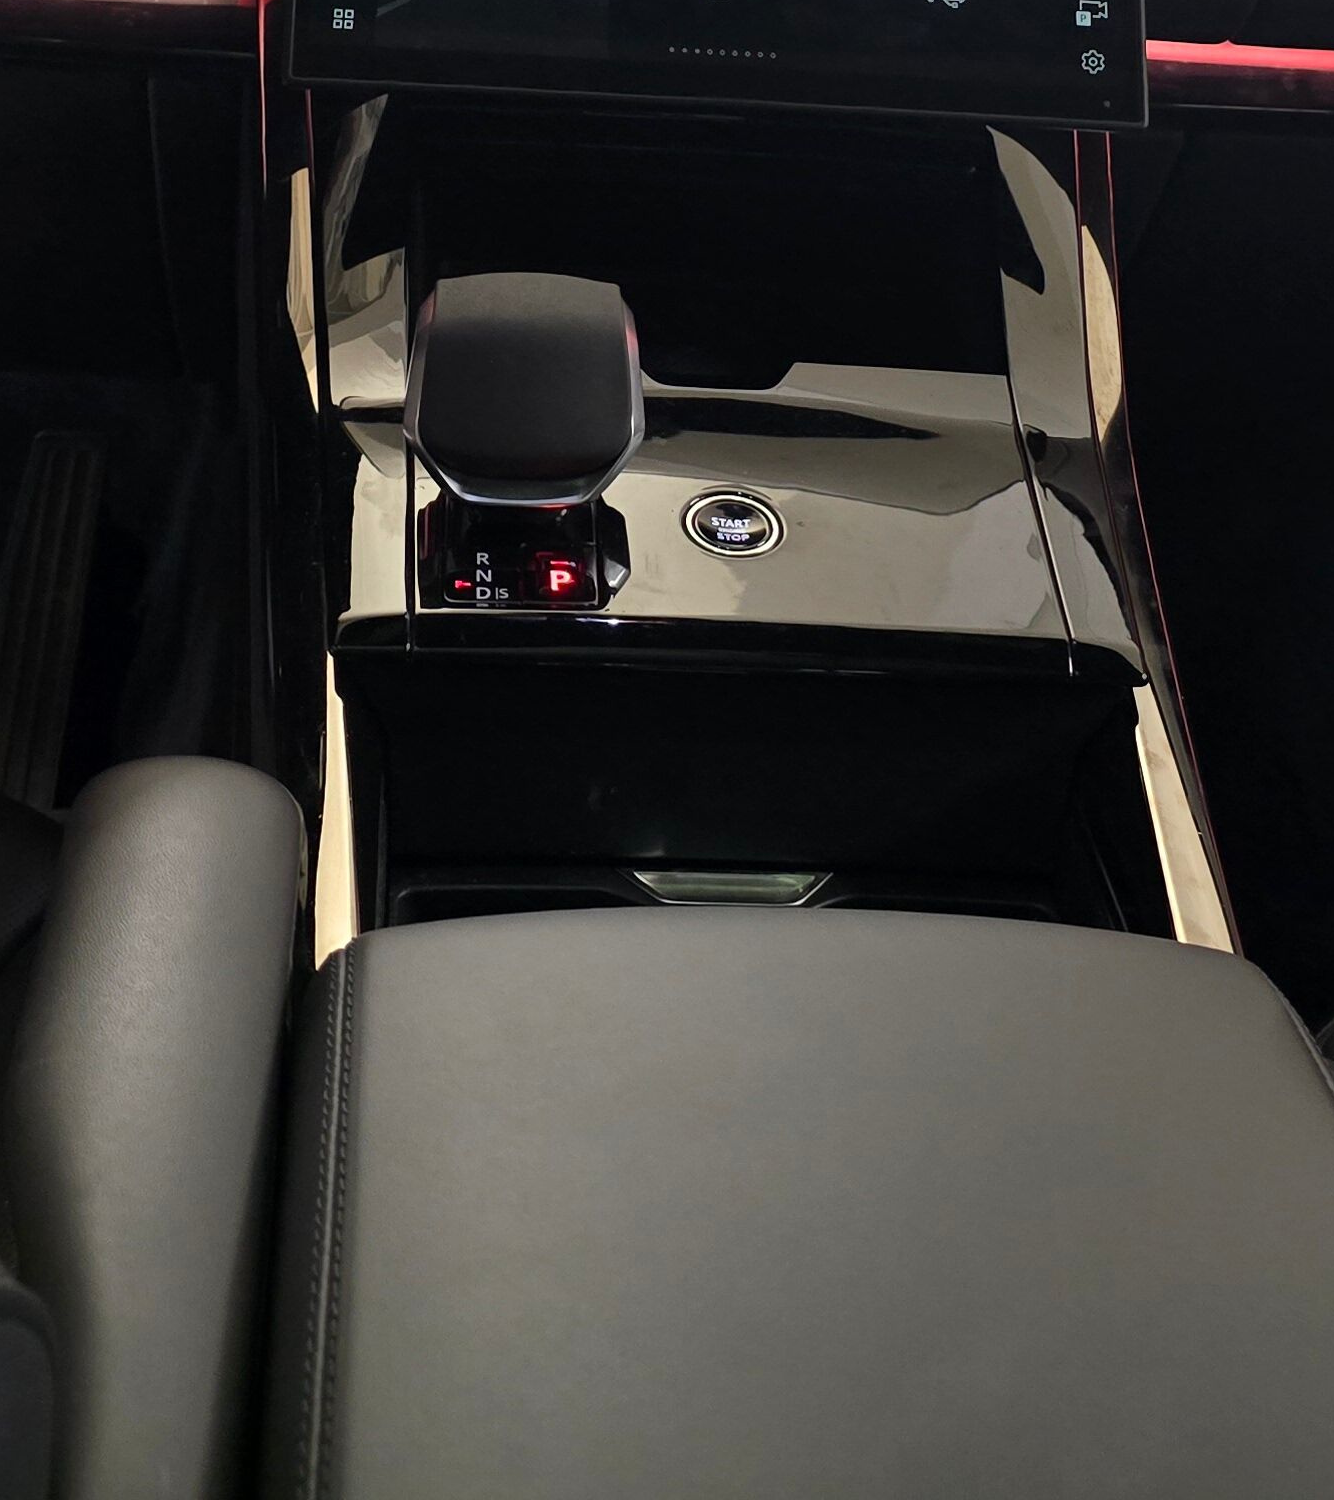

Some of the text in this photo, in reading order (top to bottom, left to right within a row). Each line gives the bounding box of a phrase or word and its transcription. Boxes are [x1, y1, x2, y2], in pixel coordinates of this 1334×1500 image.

[711, 516, 751, 529] START
[716, 532, 751, 542] STOP
[476, 552, 490, 566] R
[476, 569, 492, 583] N
[549, 569, 572, 592] P
[476, 586, 492, 600] D
